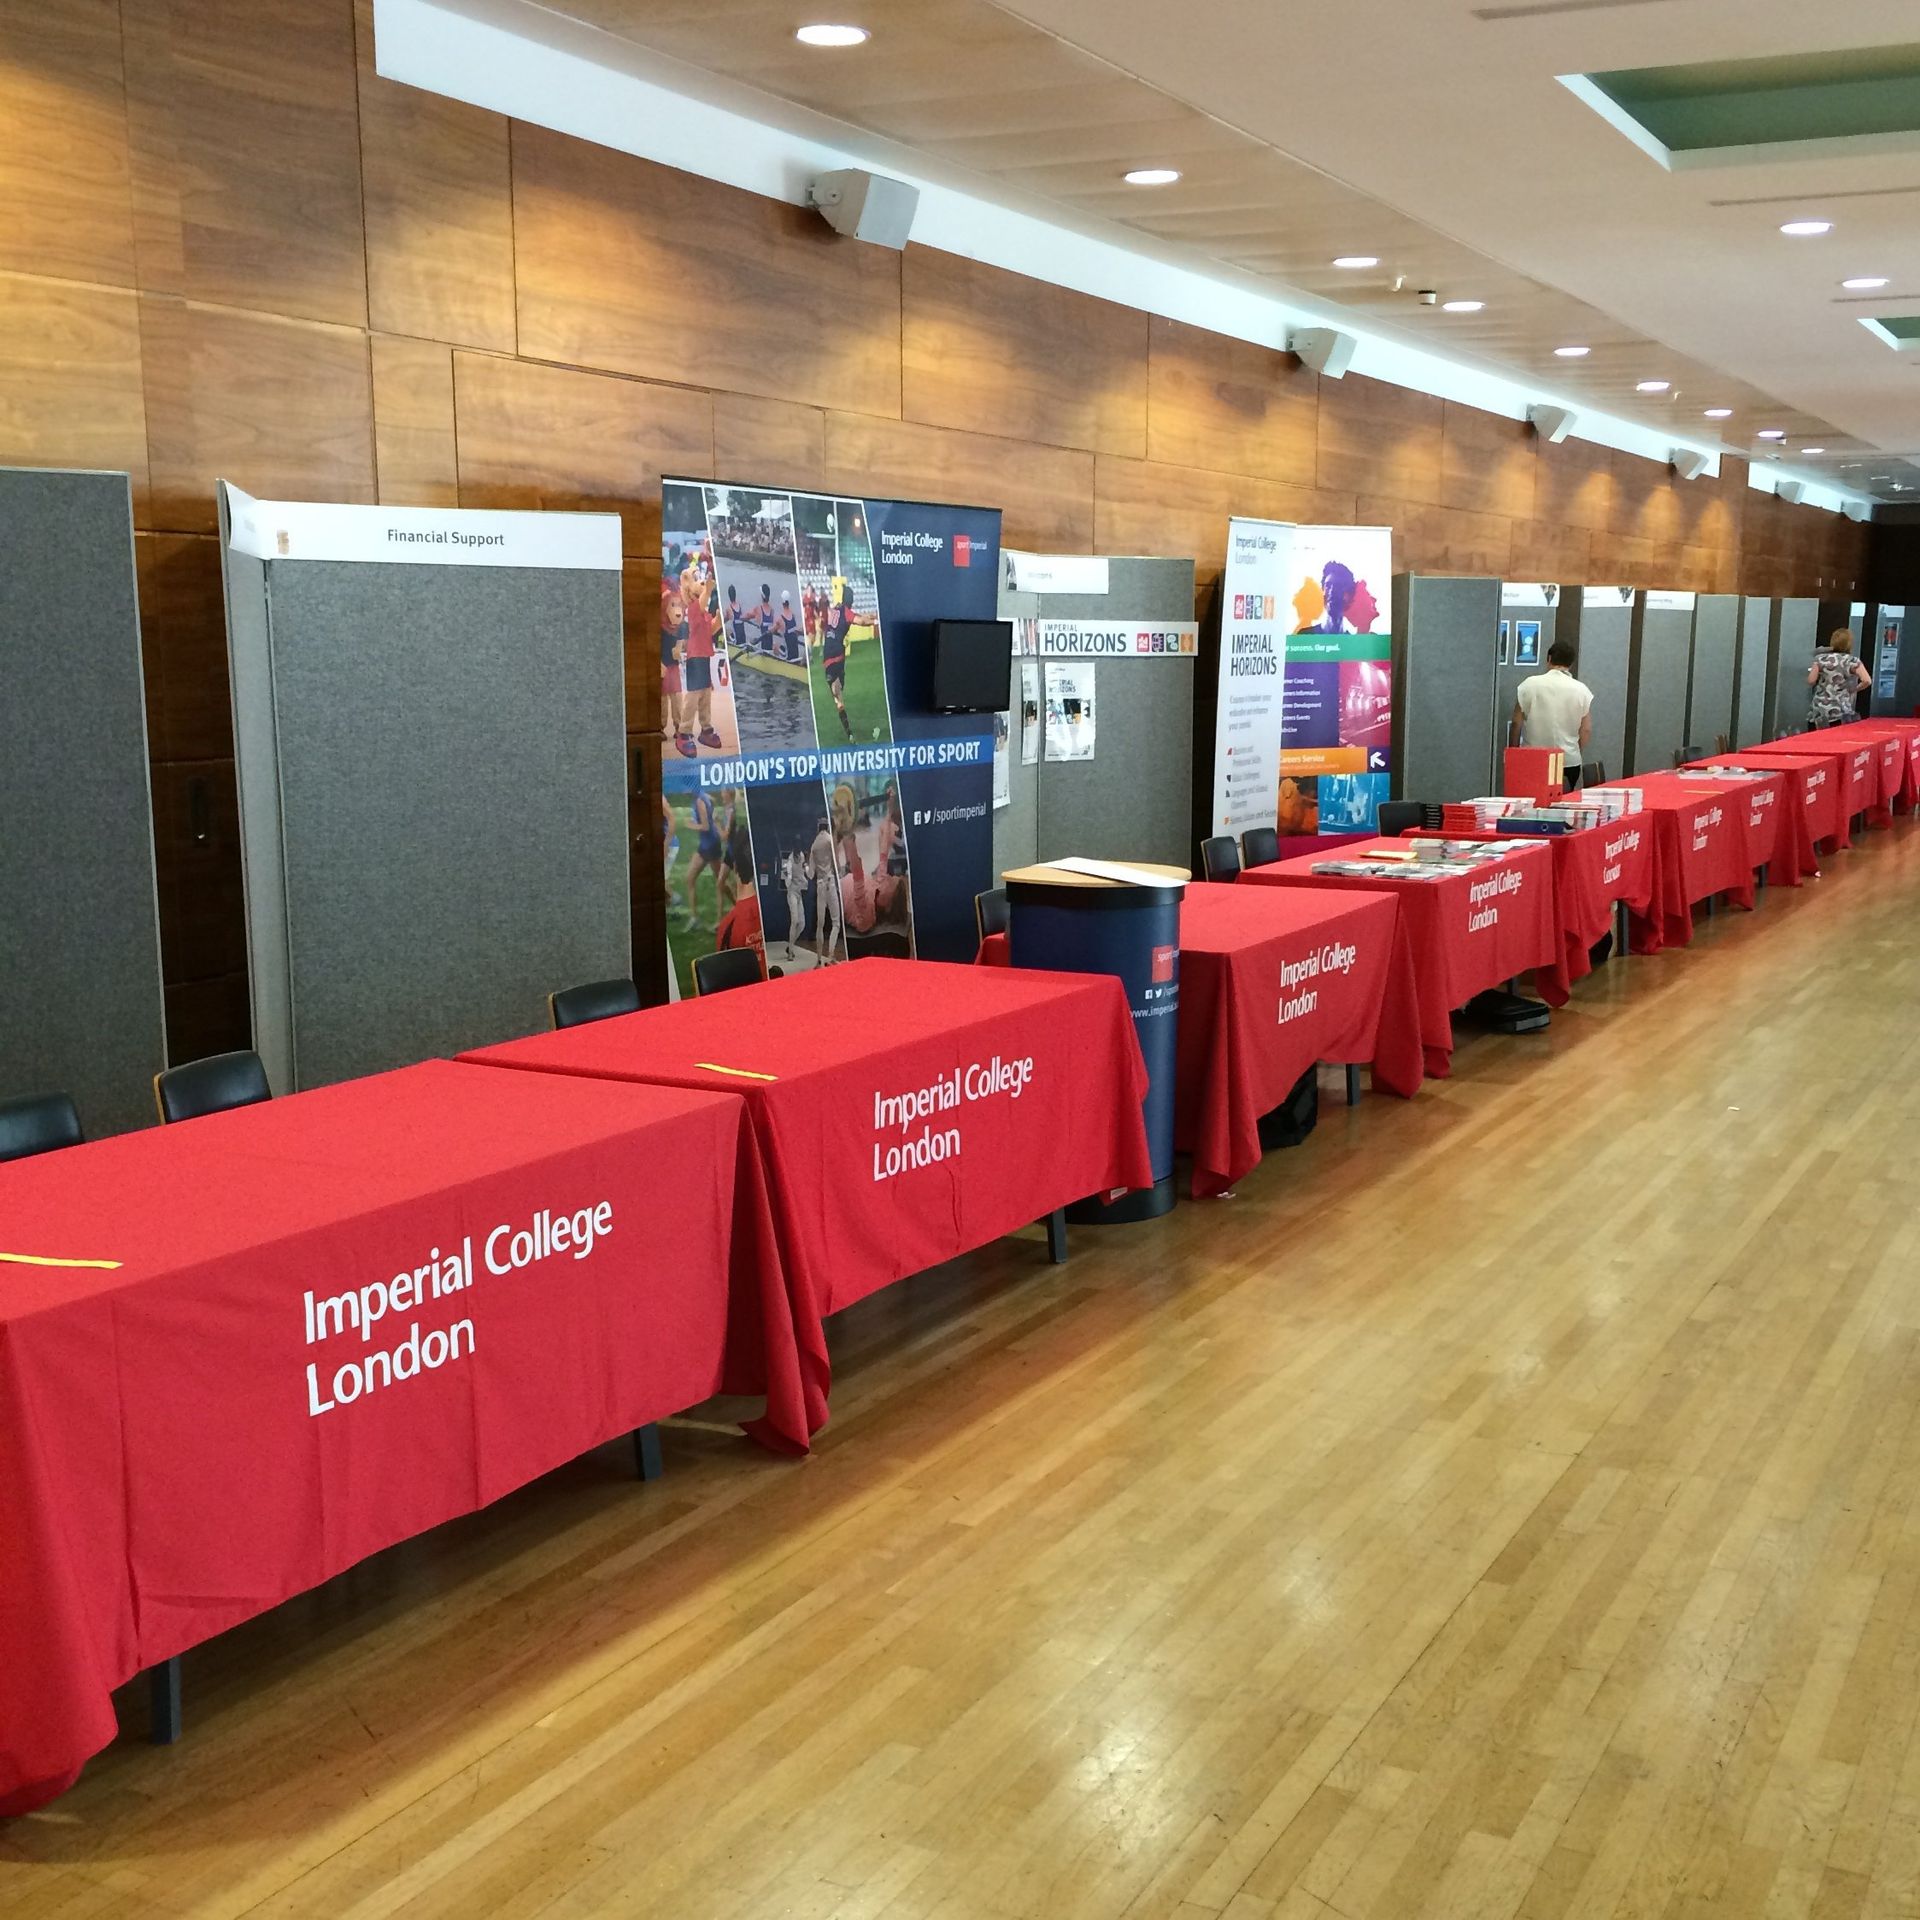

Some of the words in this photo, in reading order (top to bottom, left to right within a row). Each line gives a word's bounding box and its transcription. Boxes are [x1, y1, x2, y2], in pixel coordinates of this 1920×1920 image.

[387, 529, 448, 544] Financial
[451, 531, 505, 547] Support
[881, 530, 913, 550] Imperial
[914, 532, 943, 552] College
[1235, 535, 1257, 551] Imperial
[1257, 537, 1277, 554] College
[881, 549, 913, 565] London
[1044, 623, 1078, 632] IMPERIAL
[1044, 632, 1127, 653] HORIZONS
[1231, 634, 1273, 655] IMPERIAL
[1230, 655, 1277, 677] HORIZONS
[788, 755, 820, 777] TOP
[822, 747, 905, 774] UNIVERSITY
[909, 749, 935, 766] FOR
[938, 741, 981, 763] SPORT
[932, 802, 987, 825] /sportimperial
[1469, 872, 1499, 908] Imperial
[1498, 868, 1523, 895] College
[1468, 905, 1498, 933] London
[1280, 947, 1321, 992] Imperial
[1321, 941, 1356, 975] College
[1277, 987, 1318, 1025] London
[874, 1067, 961, 1134] Imperial
[964, 1055, 1034, 1101] College
[873, 1126, 961, 1182] London
[303, 1236, 473, 1346] Imperial
[484, 1200, 613, 1276] College
[306, 1317, 476, 1417] London
